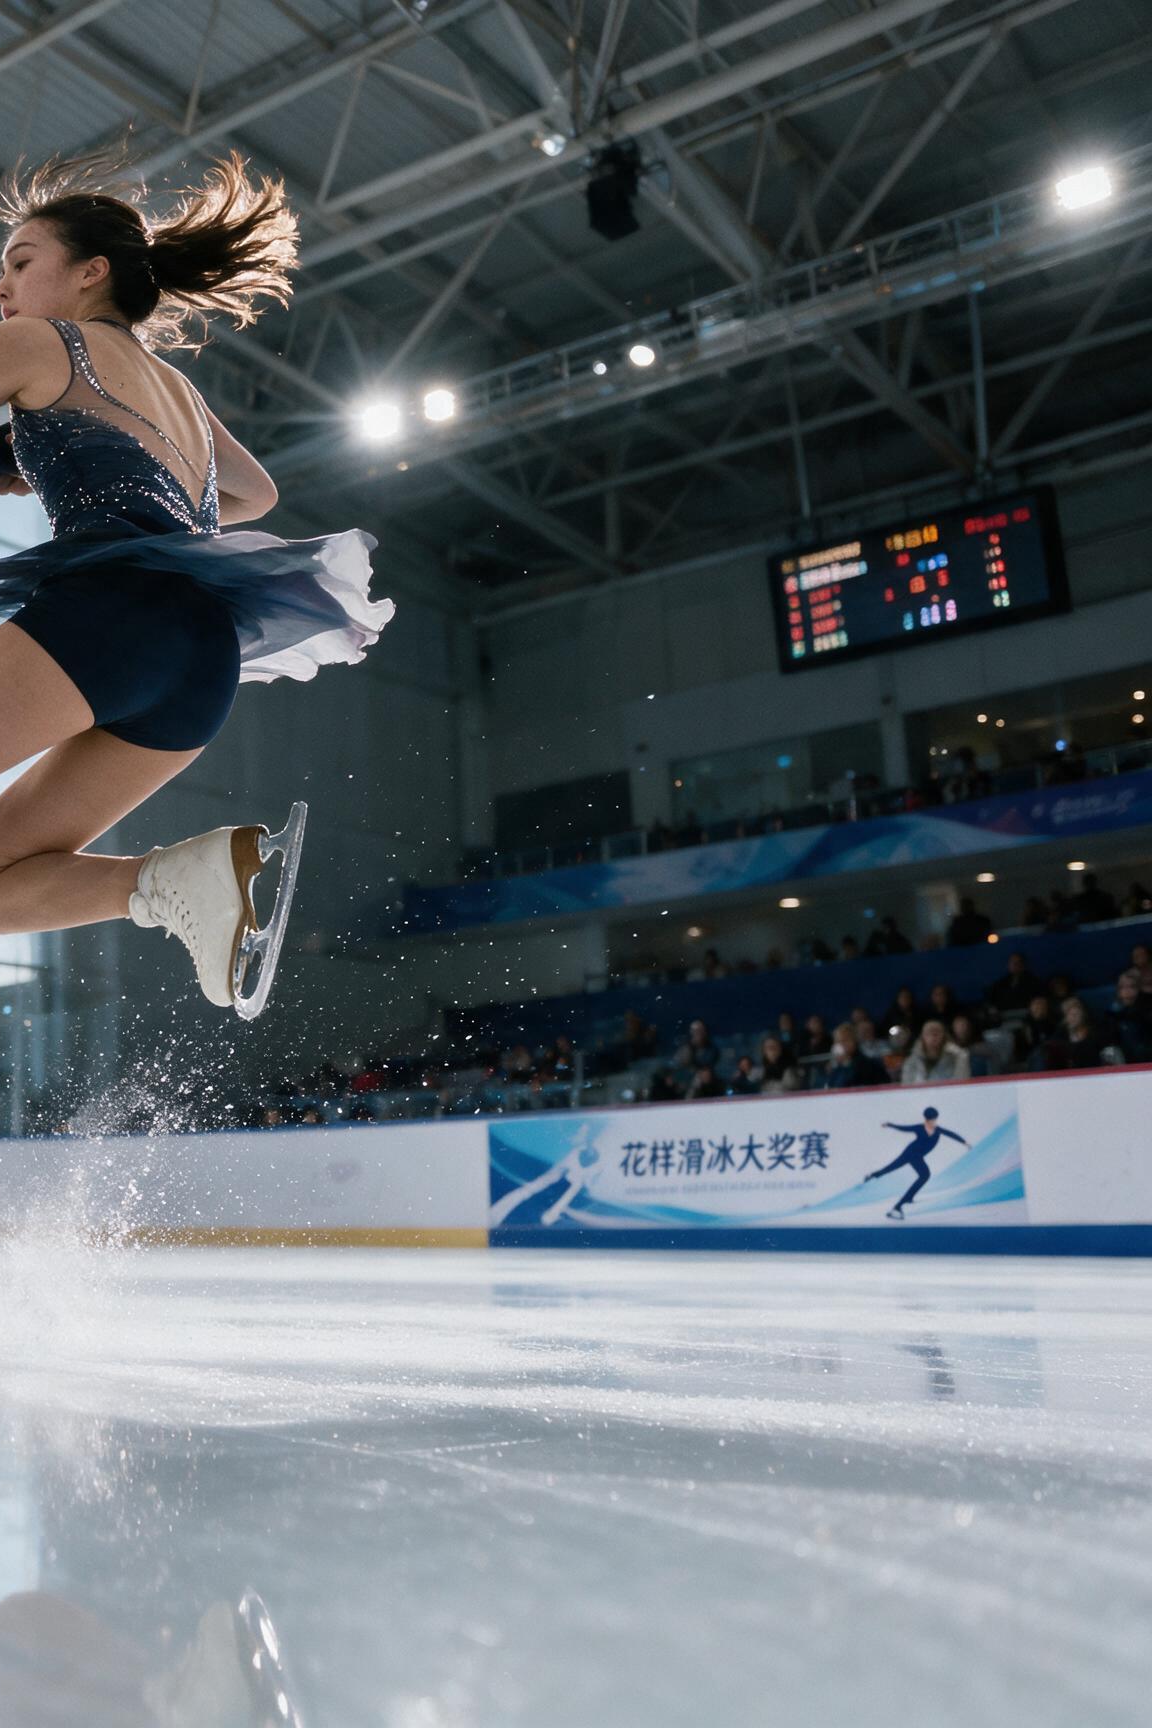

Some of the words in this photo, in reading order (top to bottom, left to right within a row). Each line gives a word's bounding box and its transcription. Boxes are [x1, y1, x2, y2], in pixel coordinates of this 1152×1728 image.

[619, 1130, 830, 1177] 花样滑冰大奖赛
